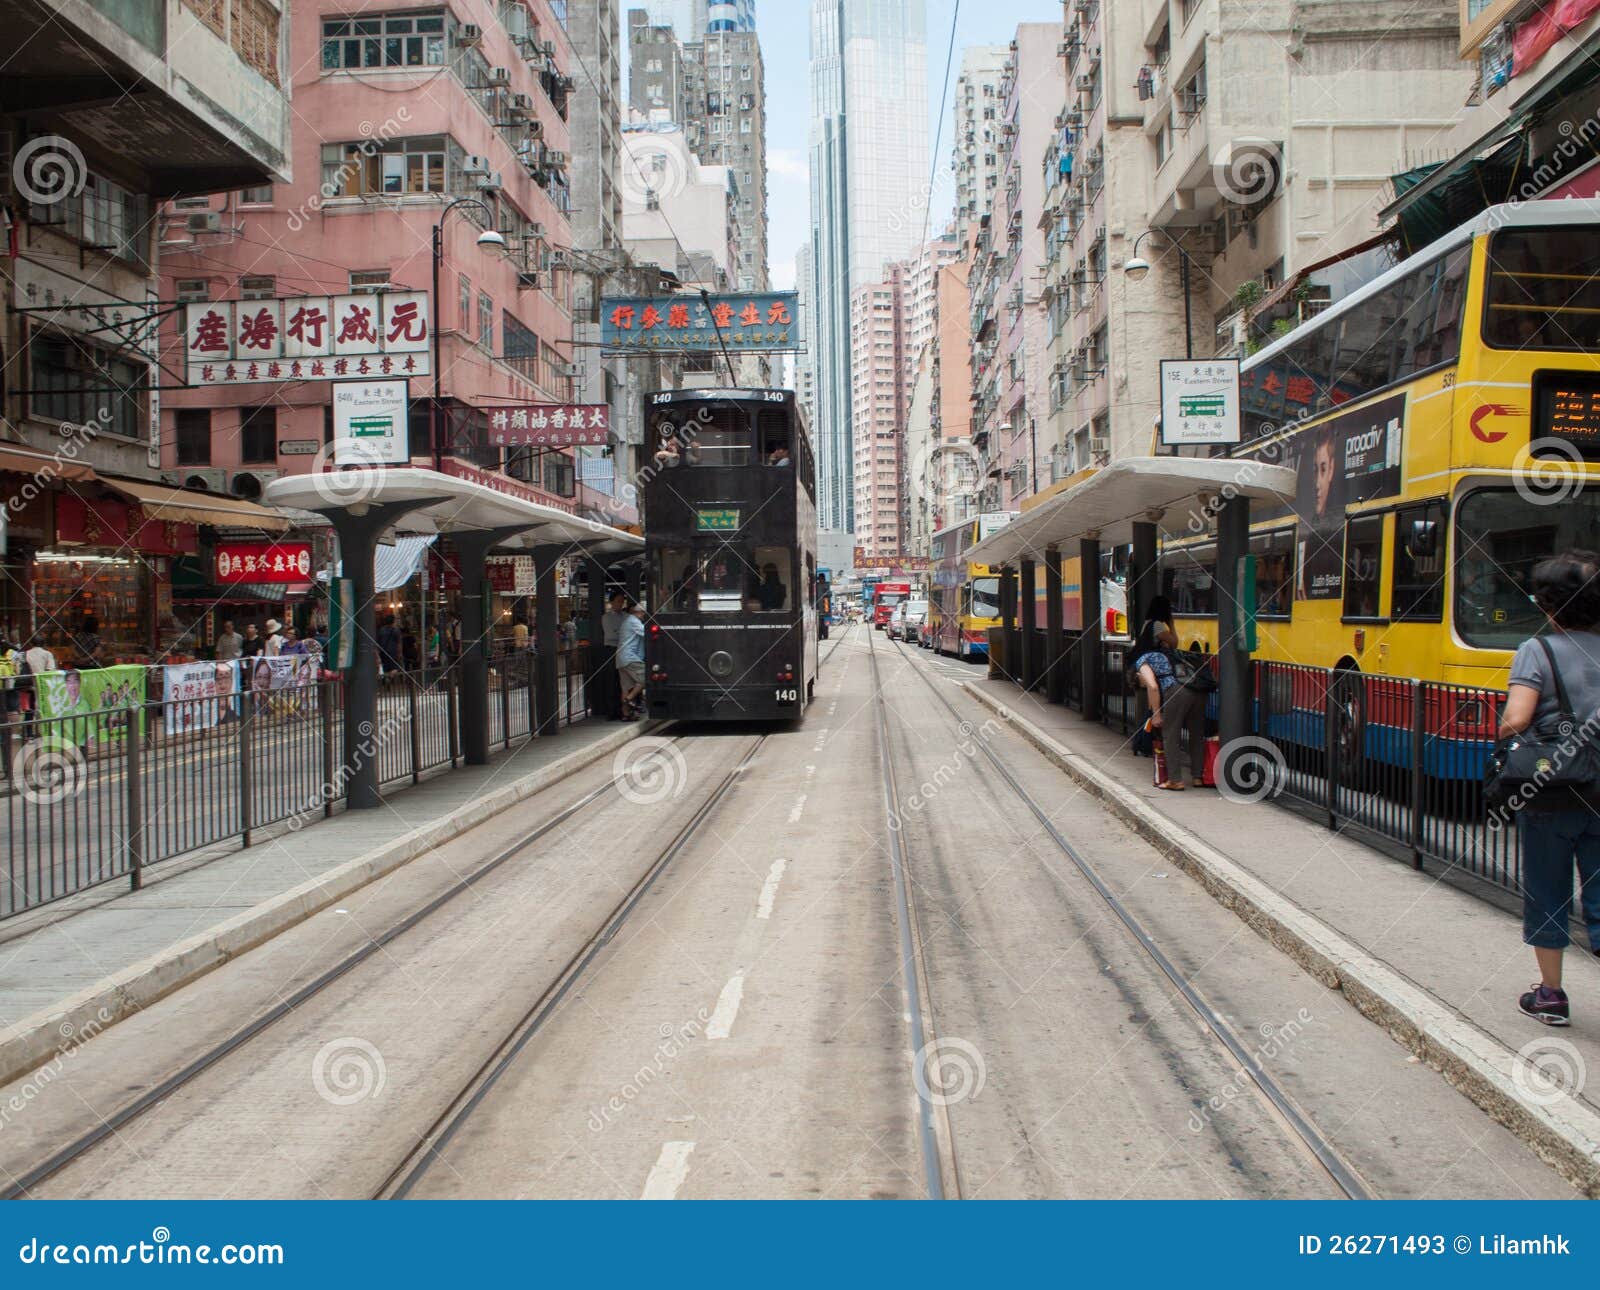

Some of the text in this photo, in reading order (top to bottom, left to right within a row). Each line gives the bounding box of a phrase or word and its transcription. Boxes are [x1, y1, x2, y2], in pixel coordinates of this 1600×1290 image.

[653, 393, 672, 404] 140
[763, 391, 784, 402] 140
[775, 689, 797, 701] 140
